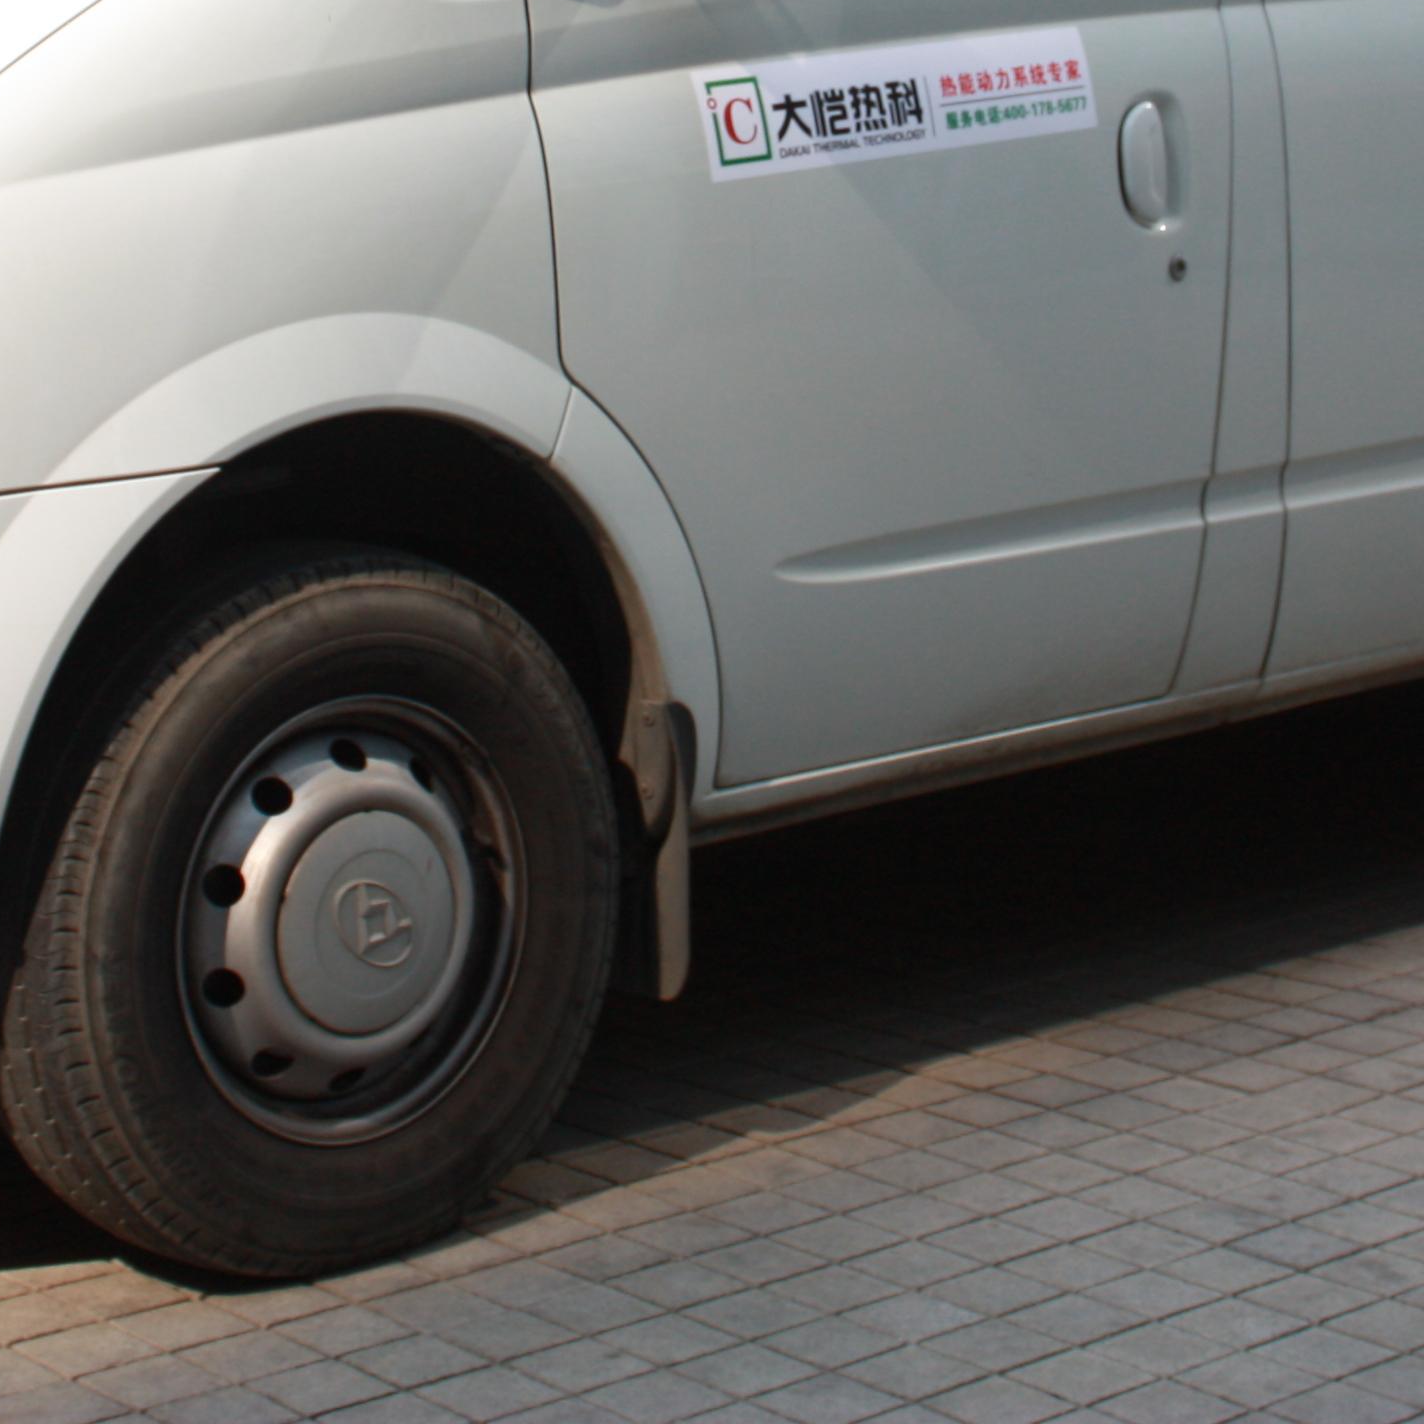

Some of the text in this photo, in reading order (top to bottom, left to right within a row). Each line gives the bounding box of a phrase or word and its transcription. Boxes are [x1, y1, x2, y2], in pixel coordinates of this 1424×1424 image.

[939, 59, 1082, 97] 热能动力系统专家
[772, 78, 923, 140] 大恺热科
[778, 129, 926, 159] DAKAI THERMAL TECHNOLOGY
